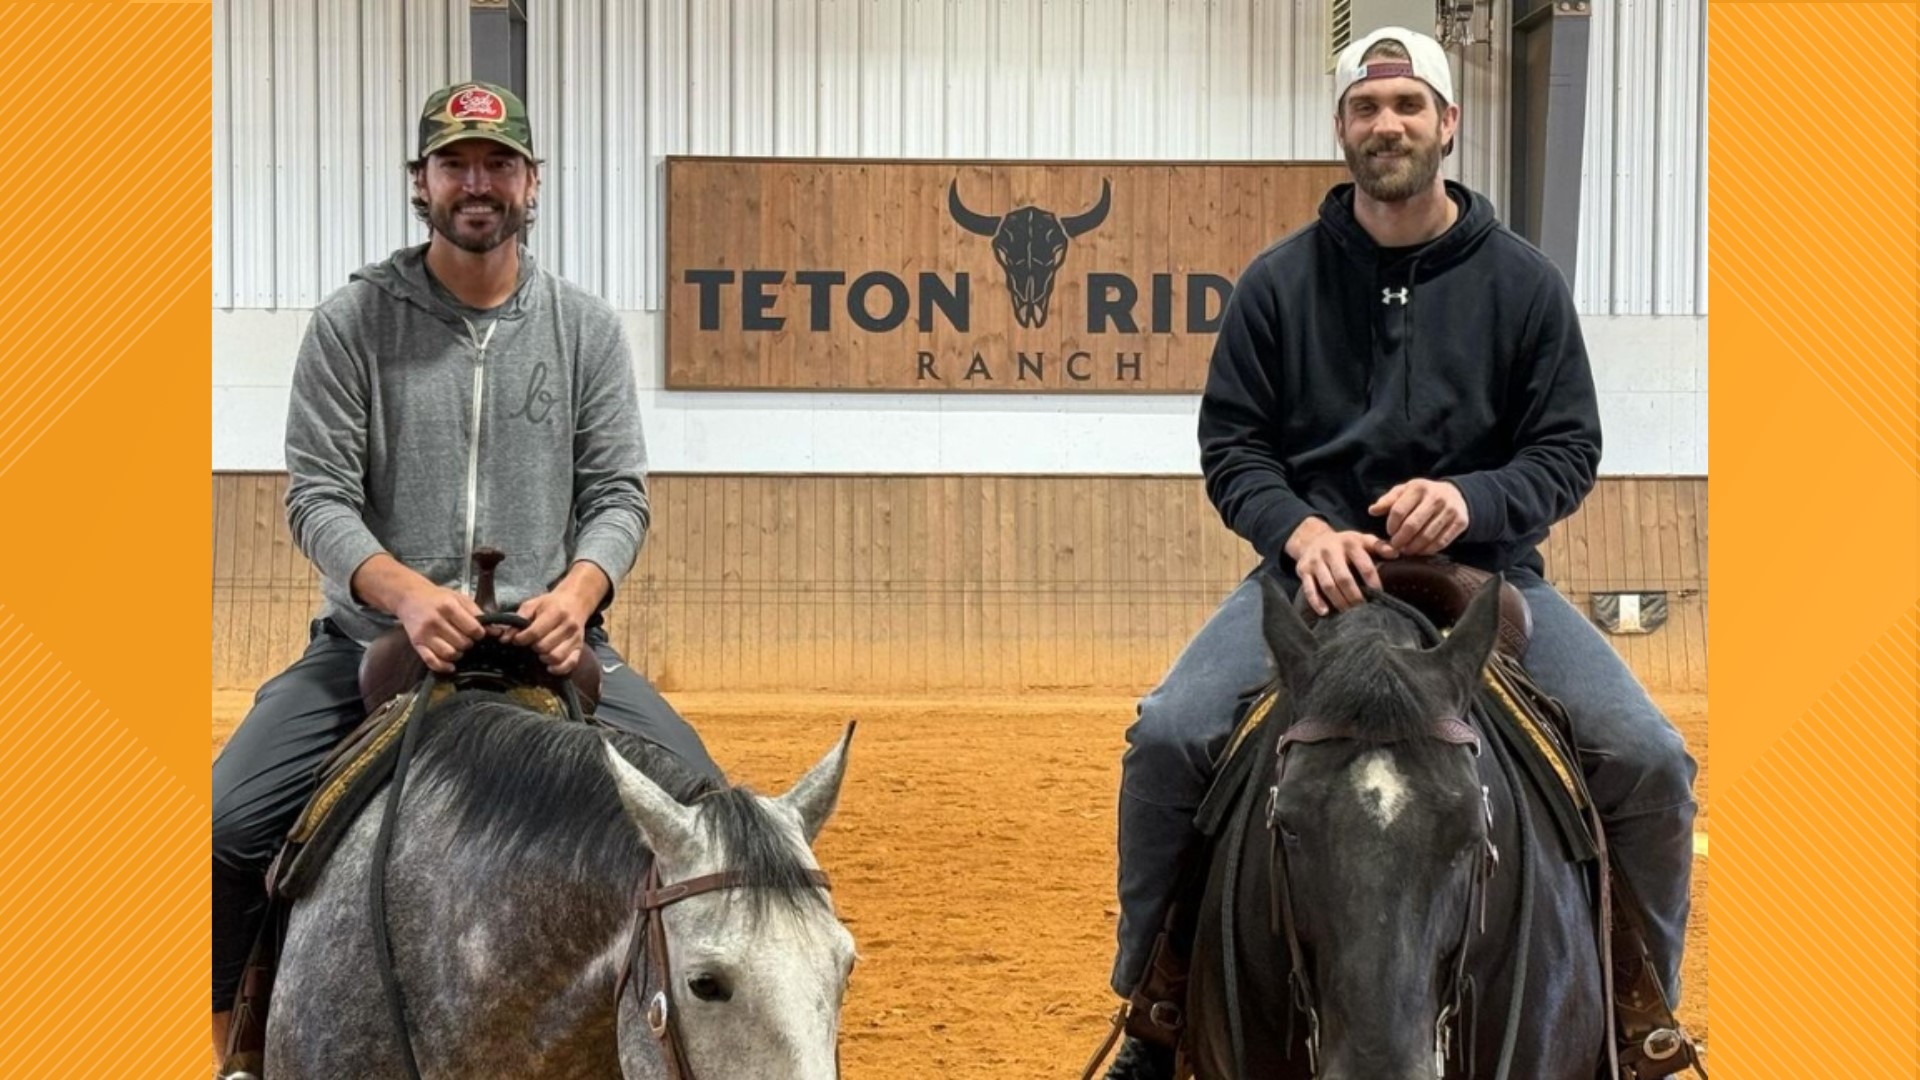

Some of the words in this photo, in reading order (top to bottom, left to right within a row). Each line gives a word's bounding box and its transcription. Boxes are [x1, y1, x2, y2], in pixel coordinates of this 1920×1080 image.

[684, 269, 970, 333] TETON
[1087, 272, 1236, 334] RID
[916, 351, 1143, 382] RANCH
